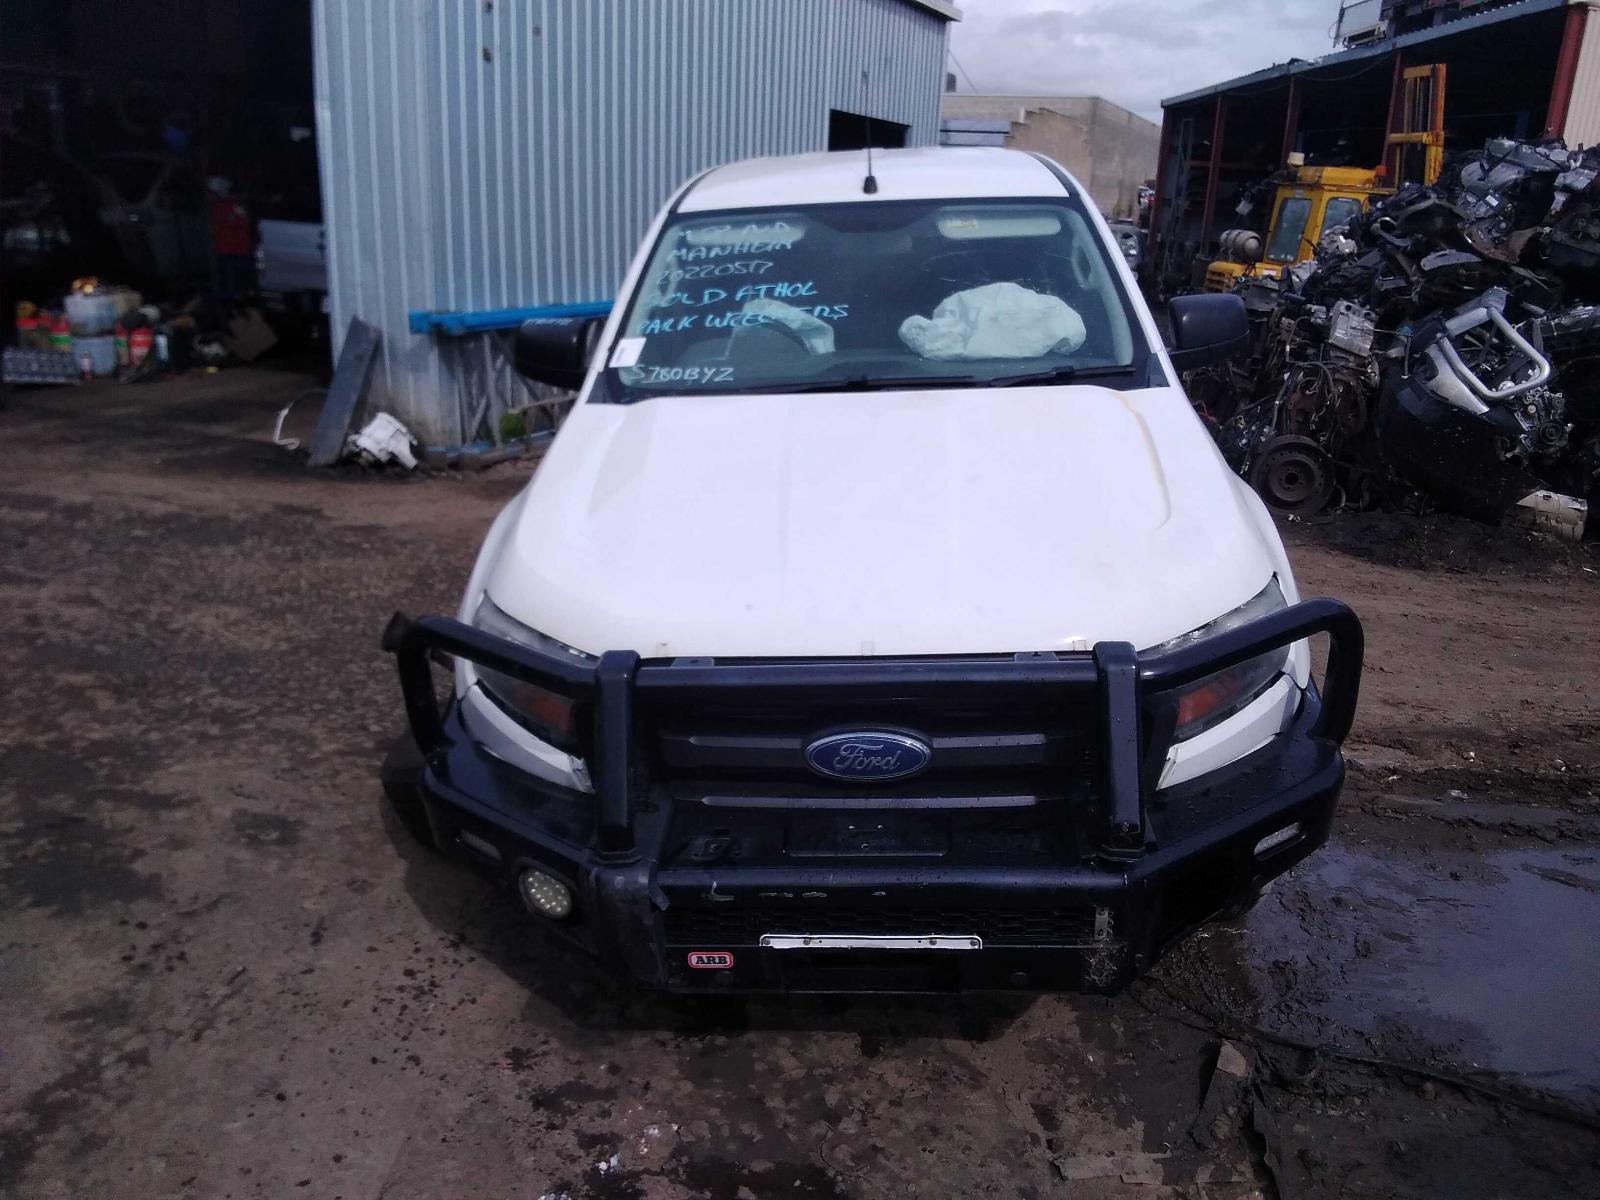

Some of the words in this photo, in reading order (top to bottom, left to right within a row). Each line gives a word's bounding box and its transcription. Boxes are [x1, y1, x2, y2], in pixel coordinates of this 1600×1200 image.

[735, 281, 820, 301] ATHOL
[637, 315, 698, 335] PARK
[833, 743, 901, 770] Ford
[694, 954, 729, 966] ARB
